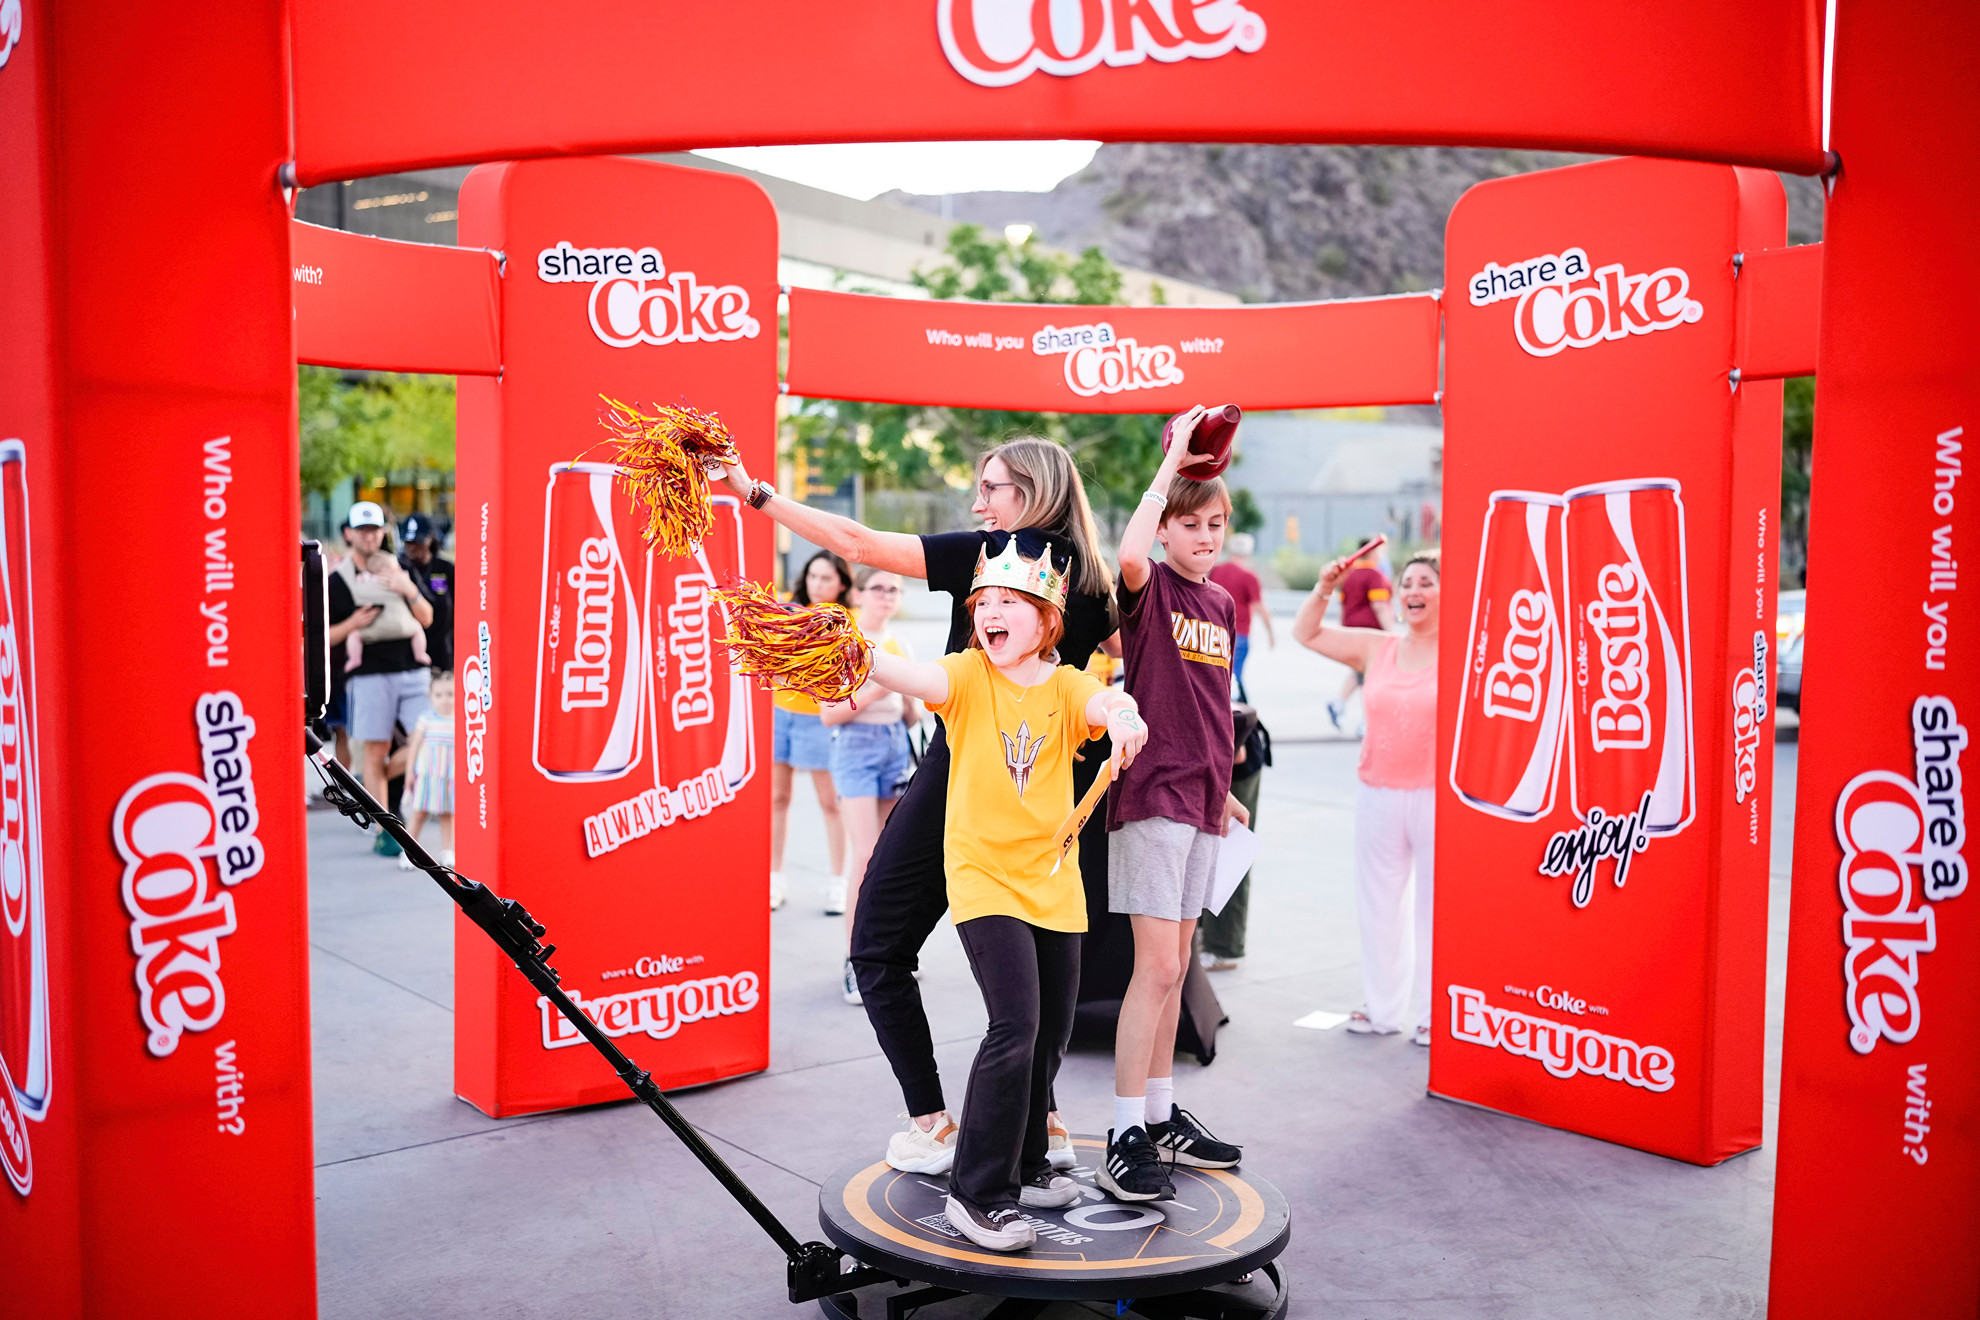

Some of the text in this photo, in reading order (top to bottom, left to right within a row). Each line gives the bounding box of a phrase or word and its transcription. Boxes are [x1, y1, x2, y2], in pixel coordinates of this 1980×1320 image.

[292, 263, 323, 285] with?
[543, 248, 659, 276] share a
[1474, 253, 1585, 300] share a
[592, 275, 748, 343] Coke
[926, 329, 1024, 351] Who will you
[1036, 327, 1111, 350] share a
[1180, 338, 1224, 354] with?
[1517, 269, 1688, 352] Coke
[1067, 343, 1174, 392] Coke
[200, 436, 234, 667] Who will you
[479, 502, 489, 611] Who will you
[1755, 508, 1767, 619] Who will you
[1922, 426, 1963, 670] Who will you
[480, 626, 489, 687] share
[549, 603, 561, 649] Coke
[564, 539, 614, 708] Homie
[656, 633, 667, 679] Coke
[671, 575, 711, 728] Buddy
[1474, 629, 1488, 675] Coke
[1487, 591, 1550, 719] Bae
[1576, 638, 1589, 687] Coke
[1590, 565, 1648, 750] Bestie
[464, 657, 485, 776] Coke
[1756, 634, 1766, 718] share a
[1735, 670, 1758, 792] Coke
[205, 701, 256, 876] share a
[479, 783, 487, 829] with?
[588, 769, 732, 852] ALWAYS COOL
[1750, 797, 1759, 845] with?
[1920, 705, 1960, 891] share a
[1543, 793, 1651, 904] enjoy!
[120, 779, 230, 1034] Coke
[1840, 778, 1931, 1037] Coke
[601, 954, 704, 980] share a Coke with
[1504, 984, 1609, 1016] share a Coke with
[541, 974, 756, 1044] Everyone
[1453, 990, 1674, 1087] Everyone
[214, 1040, 245, 1136] with?
[1903, 1063, 1930, 1166] with?
